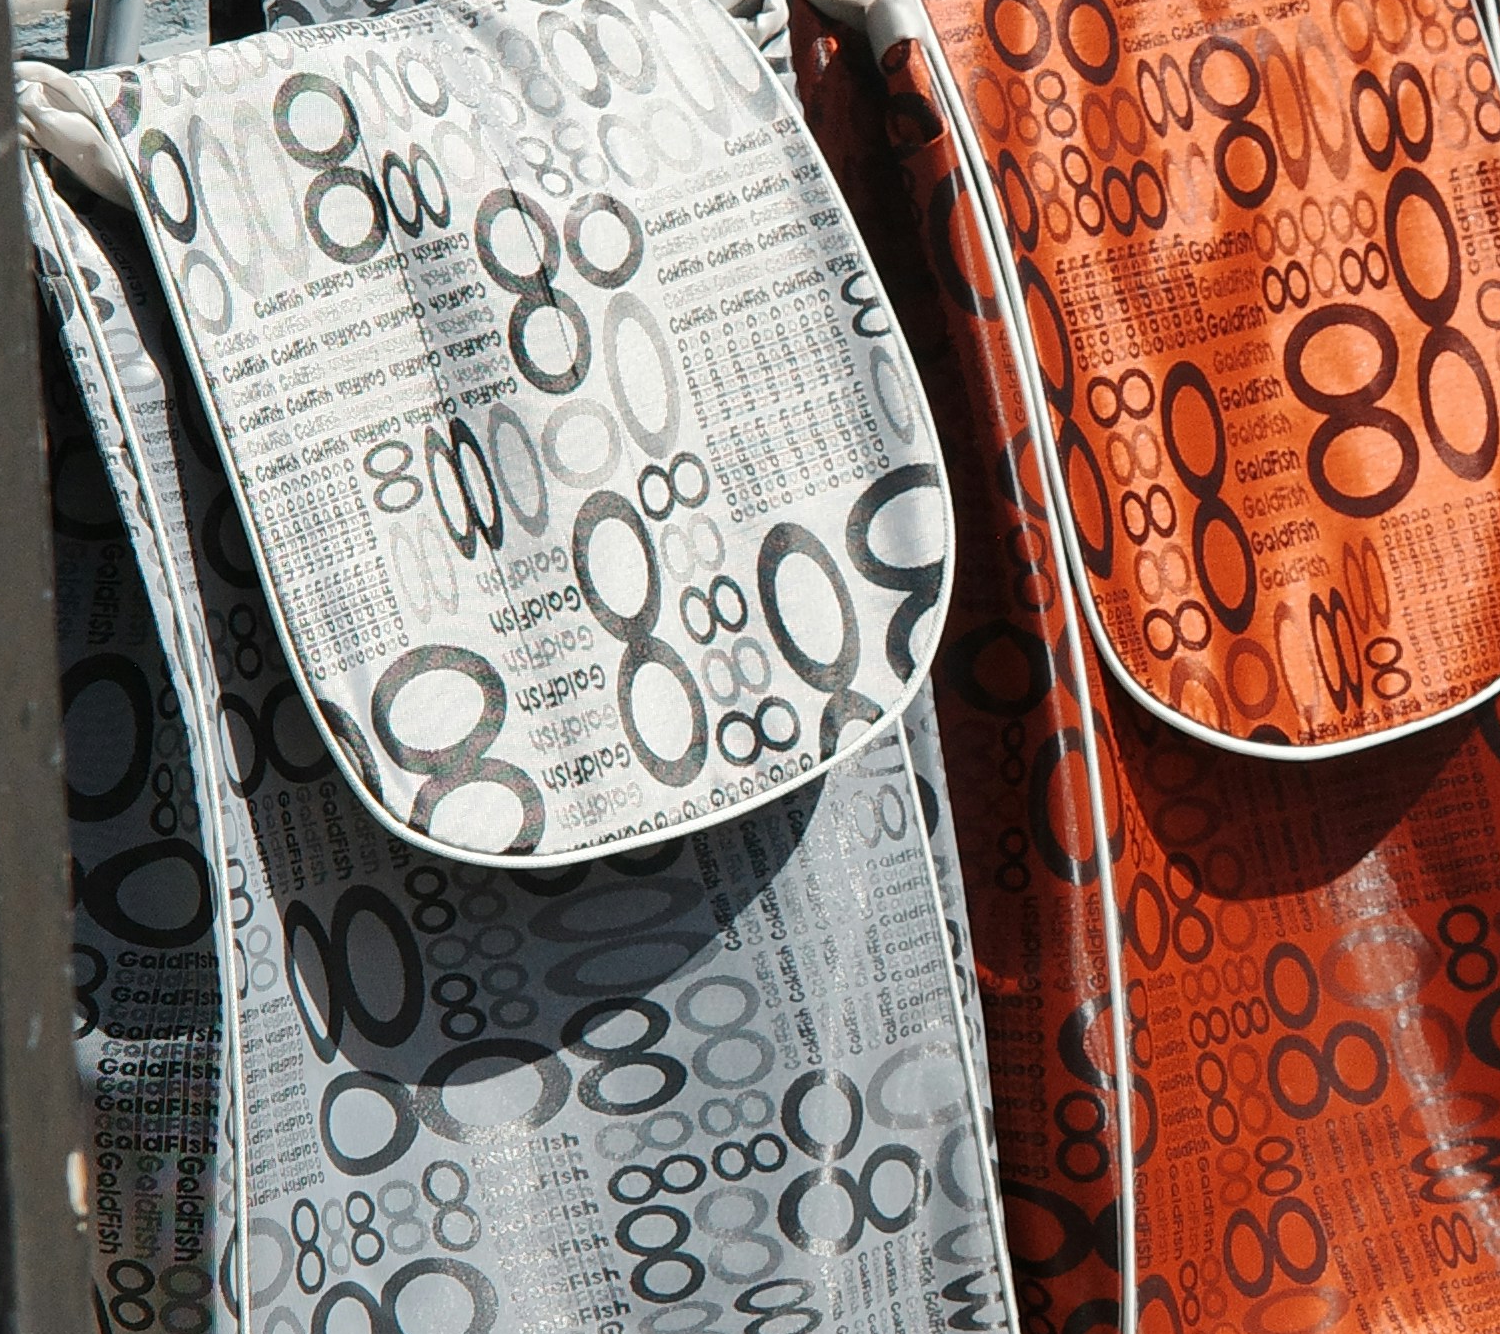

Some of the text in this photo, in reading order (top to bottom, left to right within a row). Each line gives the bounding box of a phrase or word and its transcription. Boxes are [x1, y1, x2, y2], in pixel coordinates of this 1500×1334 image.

[1188, 231, 1252, 265] GoldFish
[1206, 302, 1268, 339] GoldFish
[1219, 375, 1284, 411] GoldFish
[1228, 412, 1292, 447] GoldFish
[1234, 447, 1300, 483] GoldFish
[1242, 484, 1310, 519] GoldFish
[1252, 517, 1320, 555] GoldFish
[1260, 555, 1330, 590] GoldFish
[488, 585, 581, 636] GoldFish
[516, 664, 605, 714] GoldFish
[542, 741, 630, 793] GoldFish
[279, 791, 306, 891] GoldFish
[320, 781, 353, 880] GoldFish
[117, 950, 219, 968] GoldFish
[110, 985, 223, 1006] GoldFish
[105, 1021, 223, 1043] GoldFish
[98, 1058, 221, 1080] GoldFish
[95, 1095, 220, 1117] GoldFish
[95, 1132, 218, 1154] GoldFish
[97, 1151, 123, 1254] GoldFish
[175, 1156, 206, 1266] GoldFish
